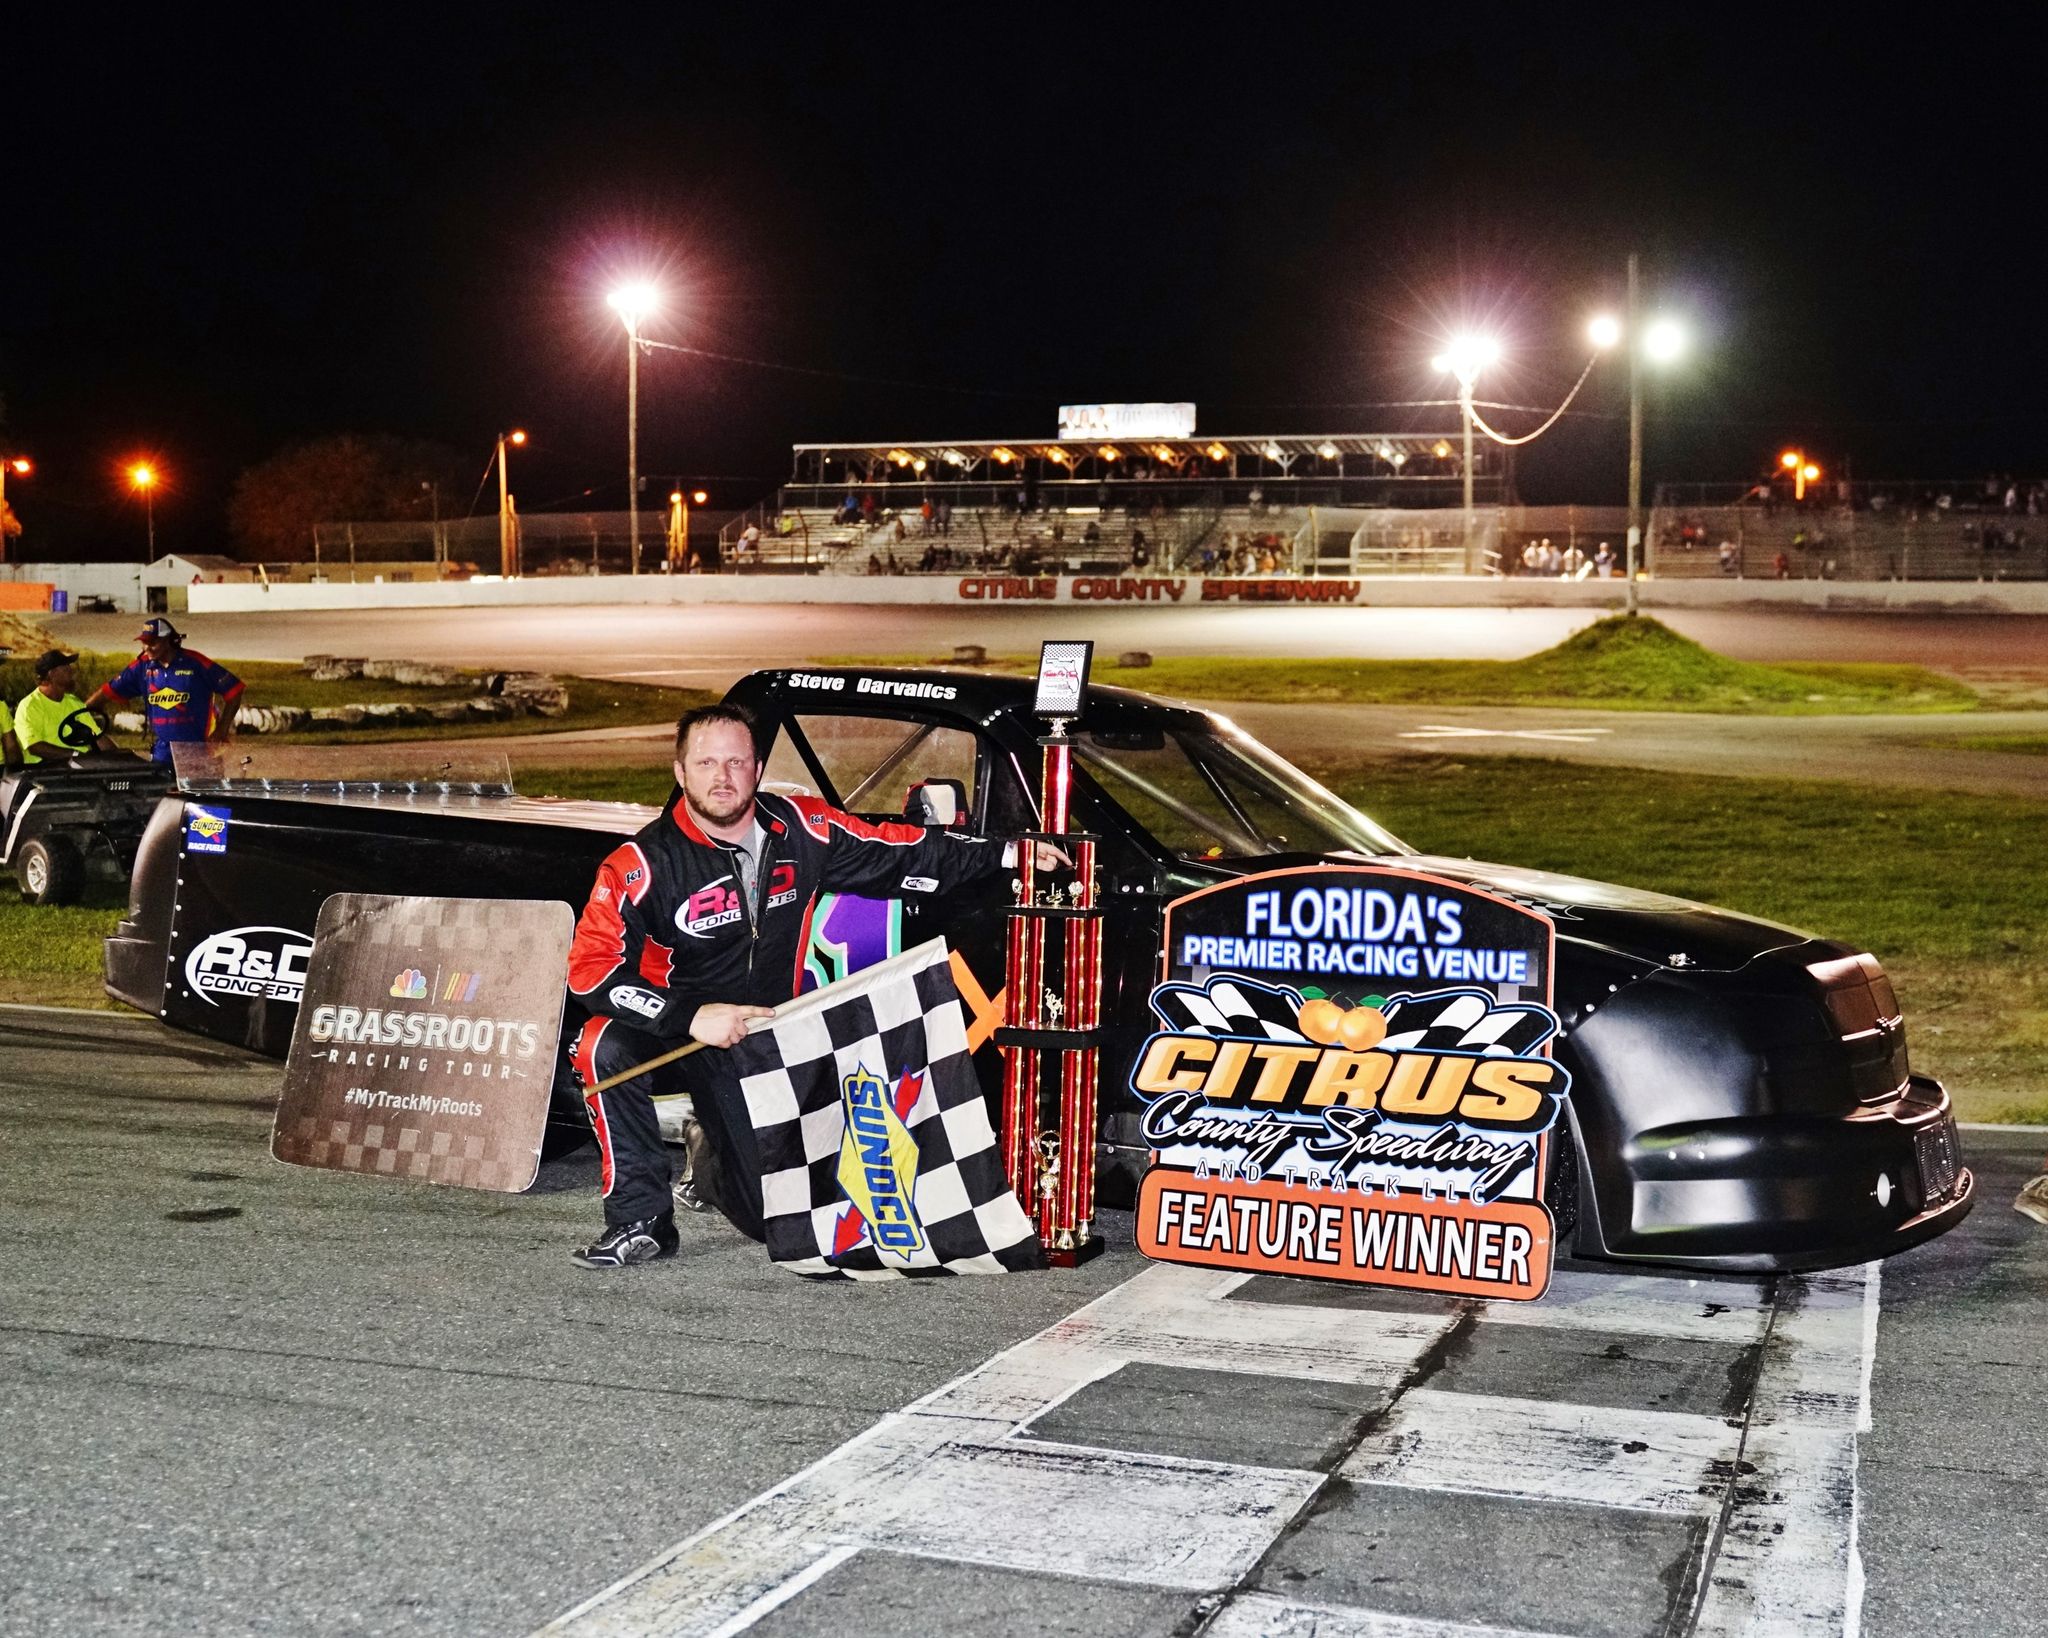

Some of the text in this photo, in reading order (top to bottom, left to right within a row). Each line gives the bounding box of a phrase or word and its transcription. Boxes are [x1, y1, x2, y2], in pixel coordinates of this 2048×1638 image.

[959, 578, 1362, 602] CITRUS COUNTY SPEEDWAY
[150, 693, 189, 703] SUNOCO
[788, 673, 957, 700] Steve Darvalics
[191, 820, 224, 832] SUNOCO
[1245, 887, 1463, 946] FLORIDA'S
[1183, 935, 1528, 982] PREMIER RACING VENUE
[199, 975, 303, 999] CONCEPT
[309, 1004, 541, 1060] GRASSROOTS
[328, 1049, 512, 1080] RACING TOUR
[1136, 1036, 1555, 1121] CITRUS
[344, 1087, 483, 1117] #MyTrackMyRoots
[1142, 1090, 1531, 1188] County Speedway
[848, 1079, 918, 1247] SUNOCO
[1196, 1160, 1486, 1204] AND TRACK LLC
[1157, 1190, 1532, 1285] FEATURE WINNER
